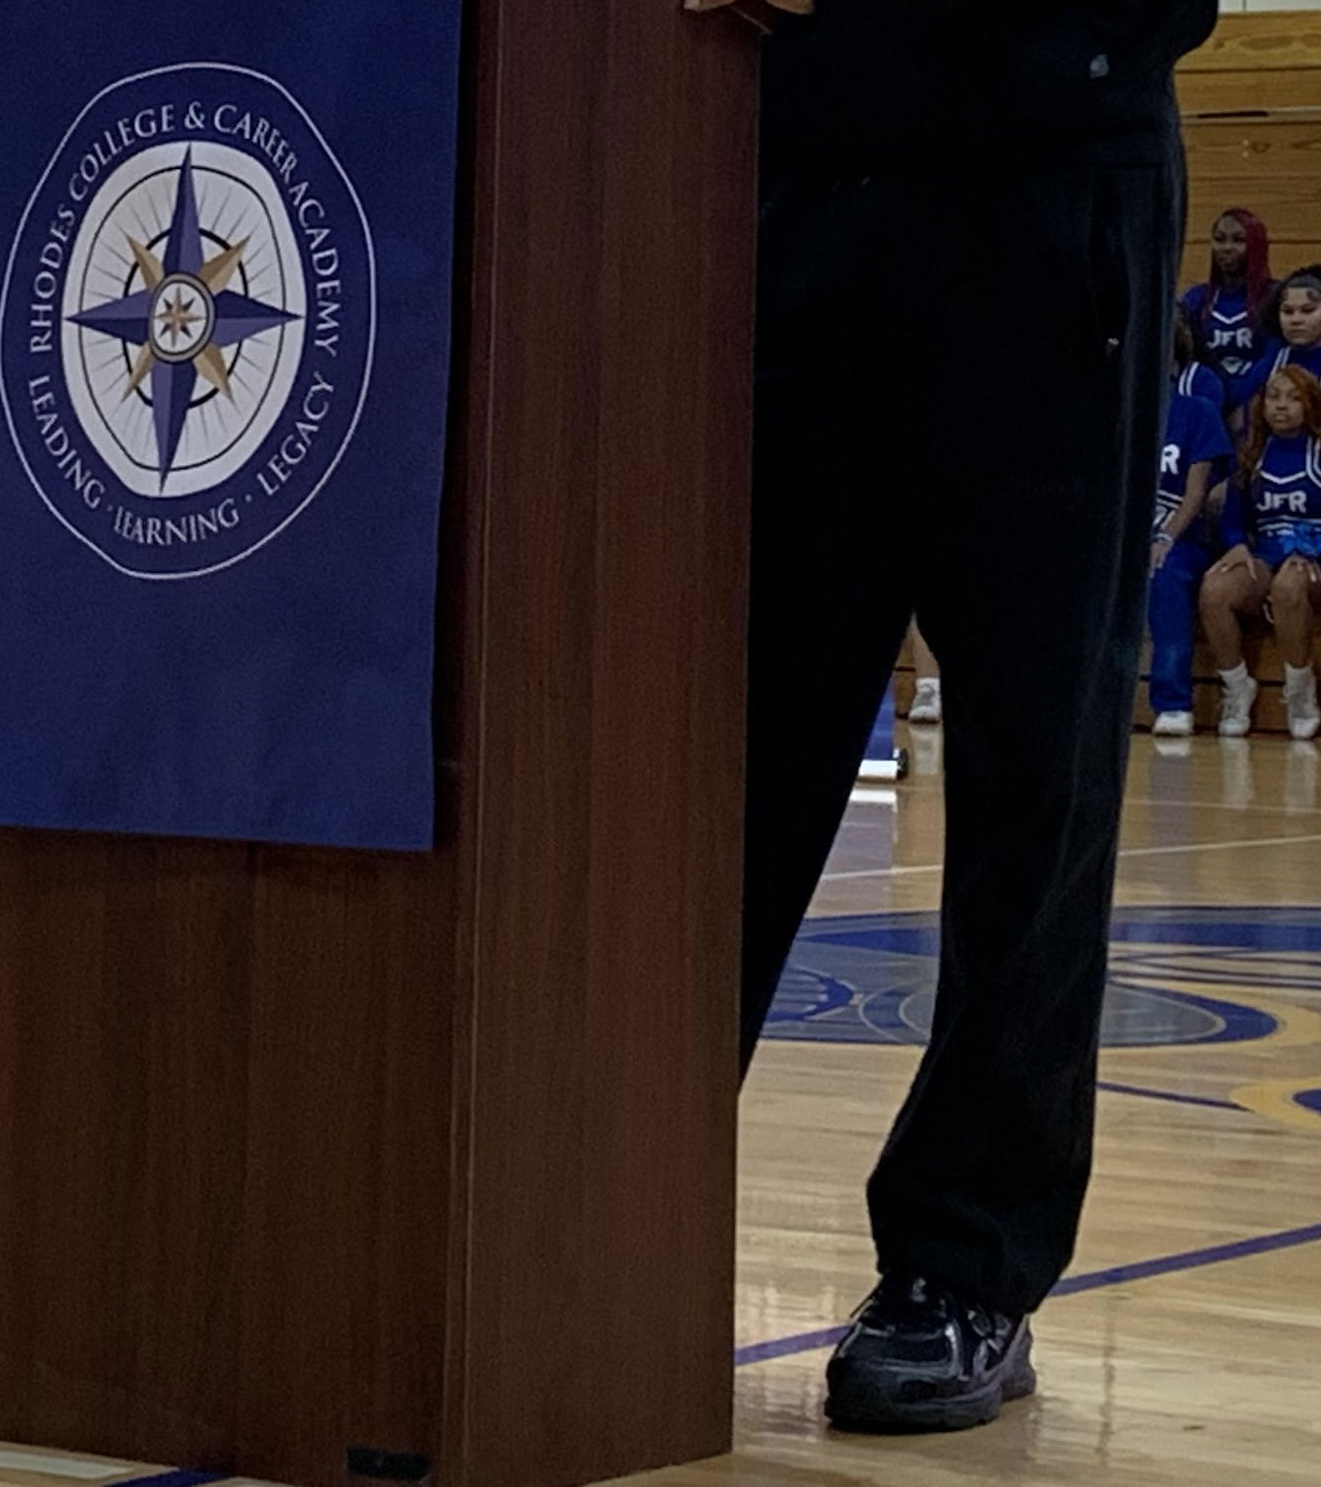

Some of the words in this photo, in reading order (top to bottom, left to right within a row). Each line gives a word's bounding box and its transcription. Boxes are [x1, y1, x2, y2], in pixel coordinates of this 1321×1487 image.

[29, 203, 76, 354] RHODES
[67, 104, 176, 202] COLLEGE
[183, 101, 206, 131] &
[213, 104, 298, 185] CAREER
[288, 181, 342, 358] ACADEMY
[1207, 327, 1253, 350] JFR
[28, 374, 107, 510] LEADING
[113, 498, 241, 547] LEARNING
[255, 369, 335, 497] LEGACY
[1256, 489, 1308, 513] JFR
